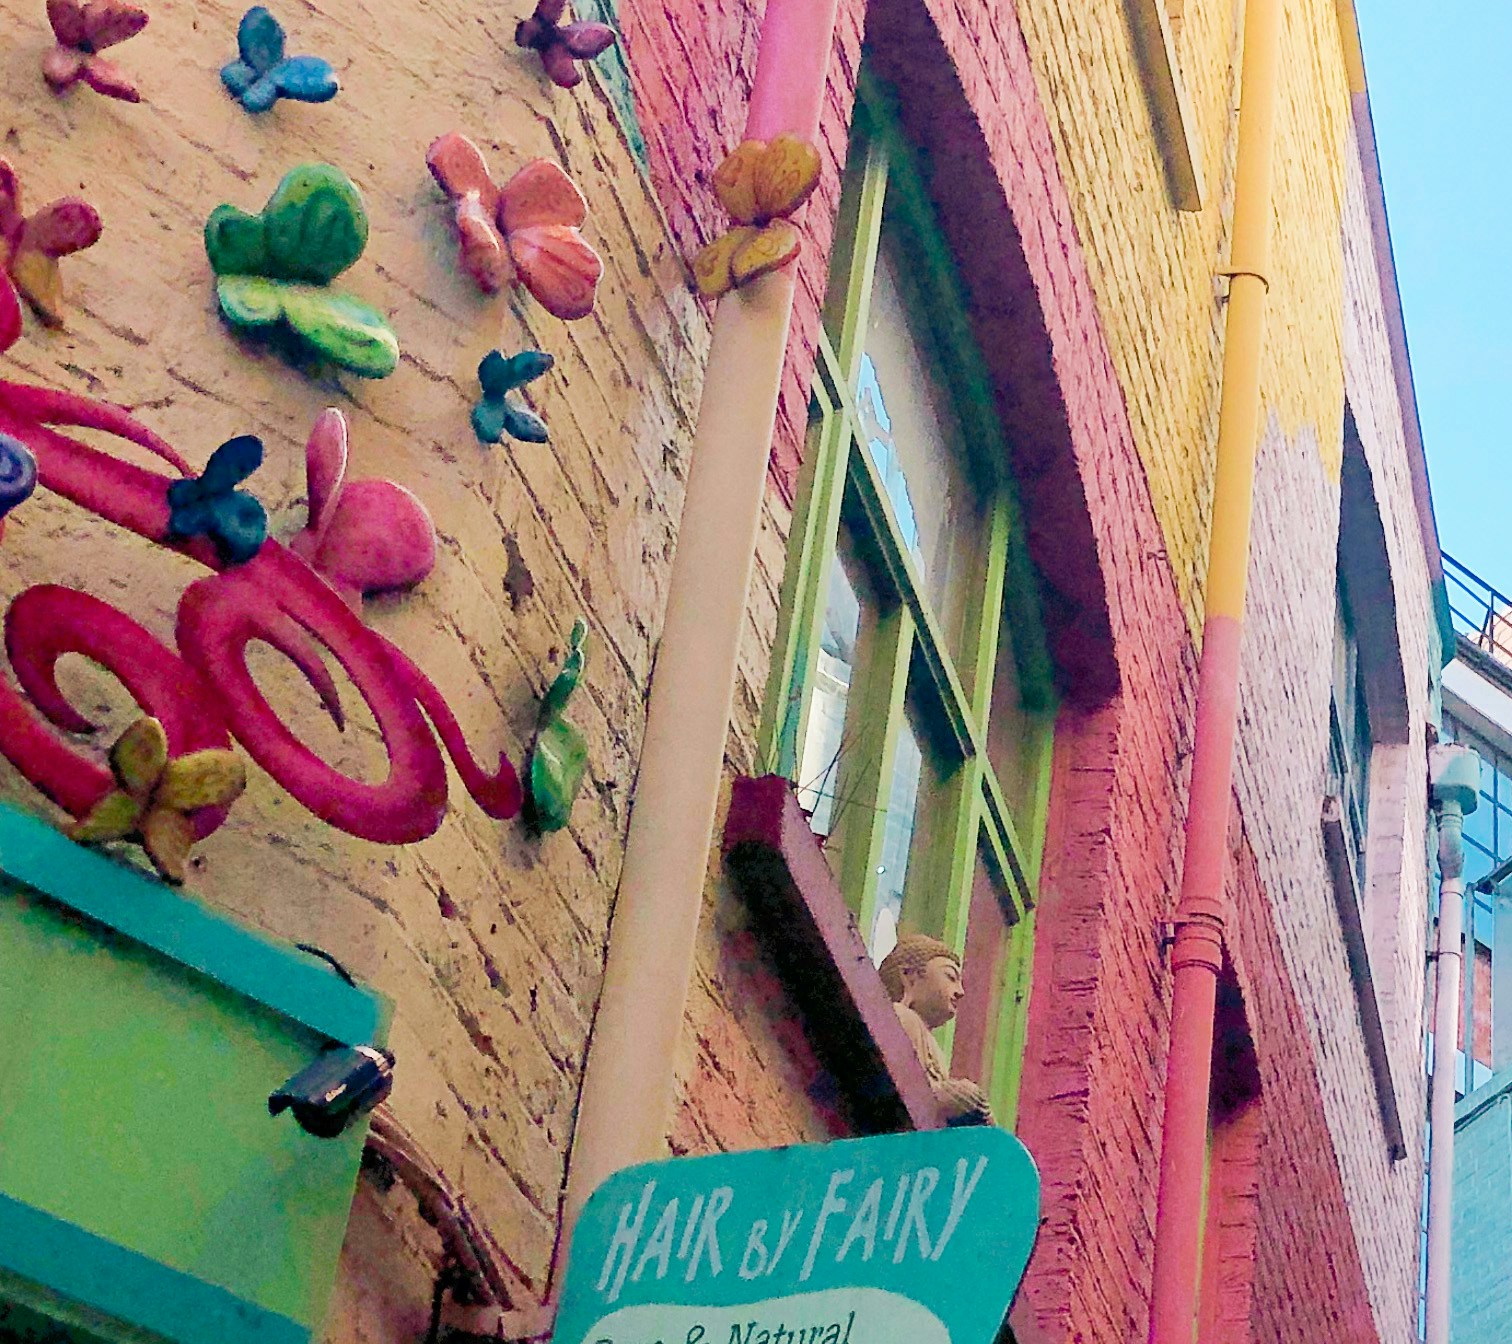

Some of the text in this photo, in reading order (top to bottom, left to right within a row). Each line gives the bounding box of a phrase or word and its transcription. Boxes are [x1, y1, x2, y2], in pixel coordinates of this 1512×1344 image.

[595, 1155, 989, 1304] HAIR BY FAIRY
